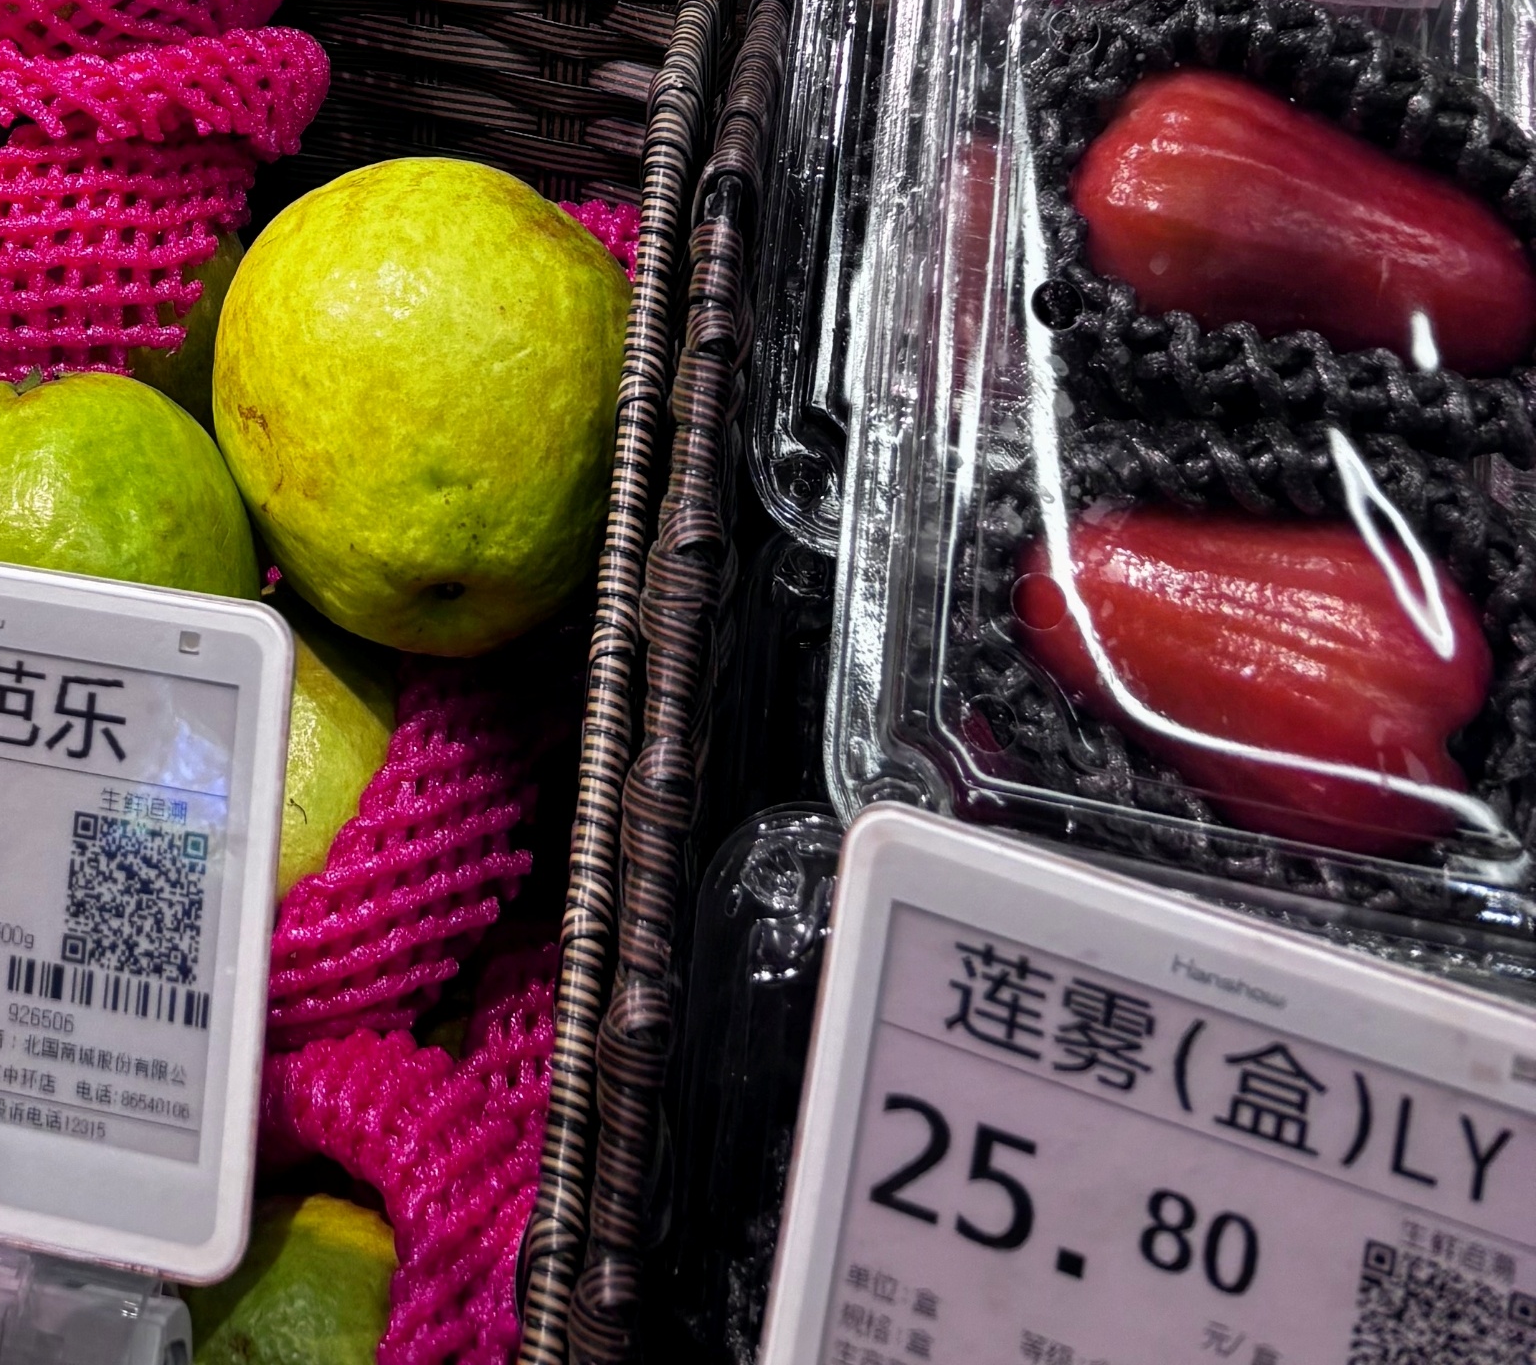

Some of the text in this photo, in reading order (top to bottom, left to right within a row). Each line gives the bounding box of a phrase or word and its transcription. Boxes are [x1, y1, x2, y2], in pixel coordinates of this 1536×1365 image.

[100, 786, 189, 827] 生鲜追溯
[1171, 954, 1287, 1009] Hanshow
[8, 1003, 75, 1033] 926506
